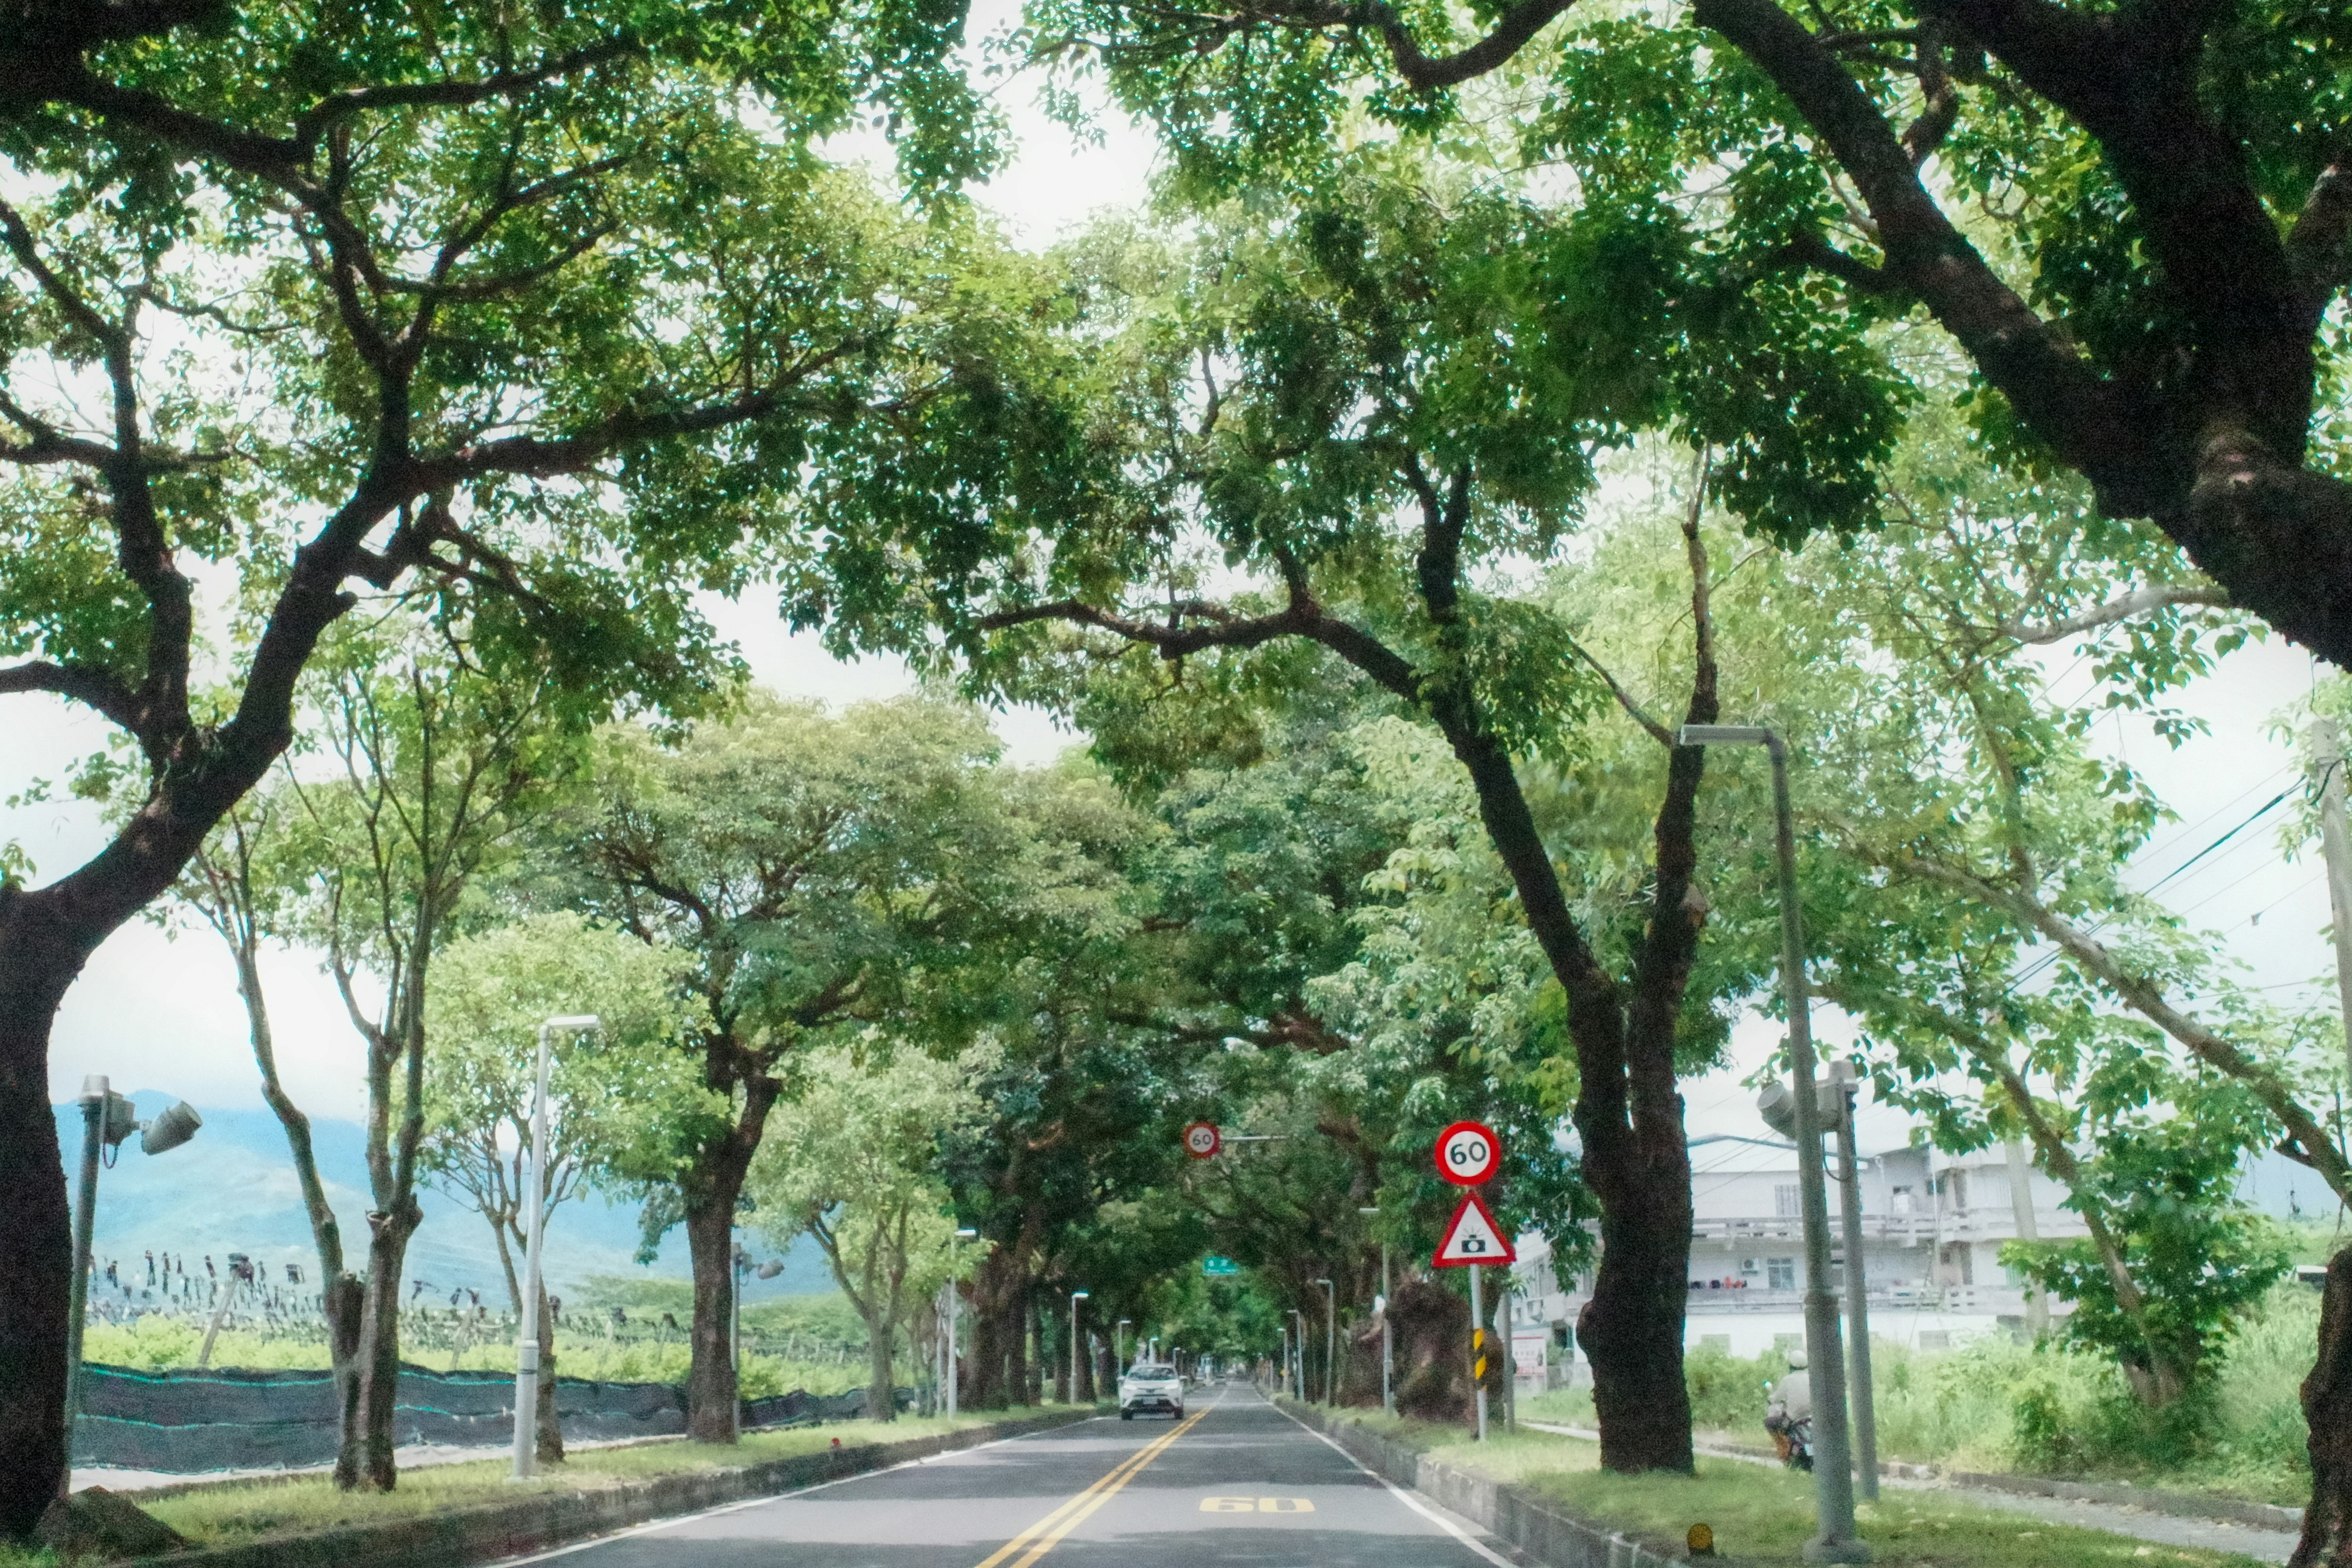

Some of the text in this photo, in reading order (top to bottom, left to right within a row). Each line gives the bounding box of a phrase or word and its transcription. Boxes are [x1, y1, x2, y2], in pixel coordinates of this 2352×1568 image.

[1193, 1134, 1211, 1145] 60
[1450, 1141, 1486, 1165] 60
[1199, 1497, 1315, 1512] 60
